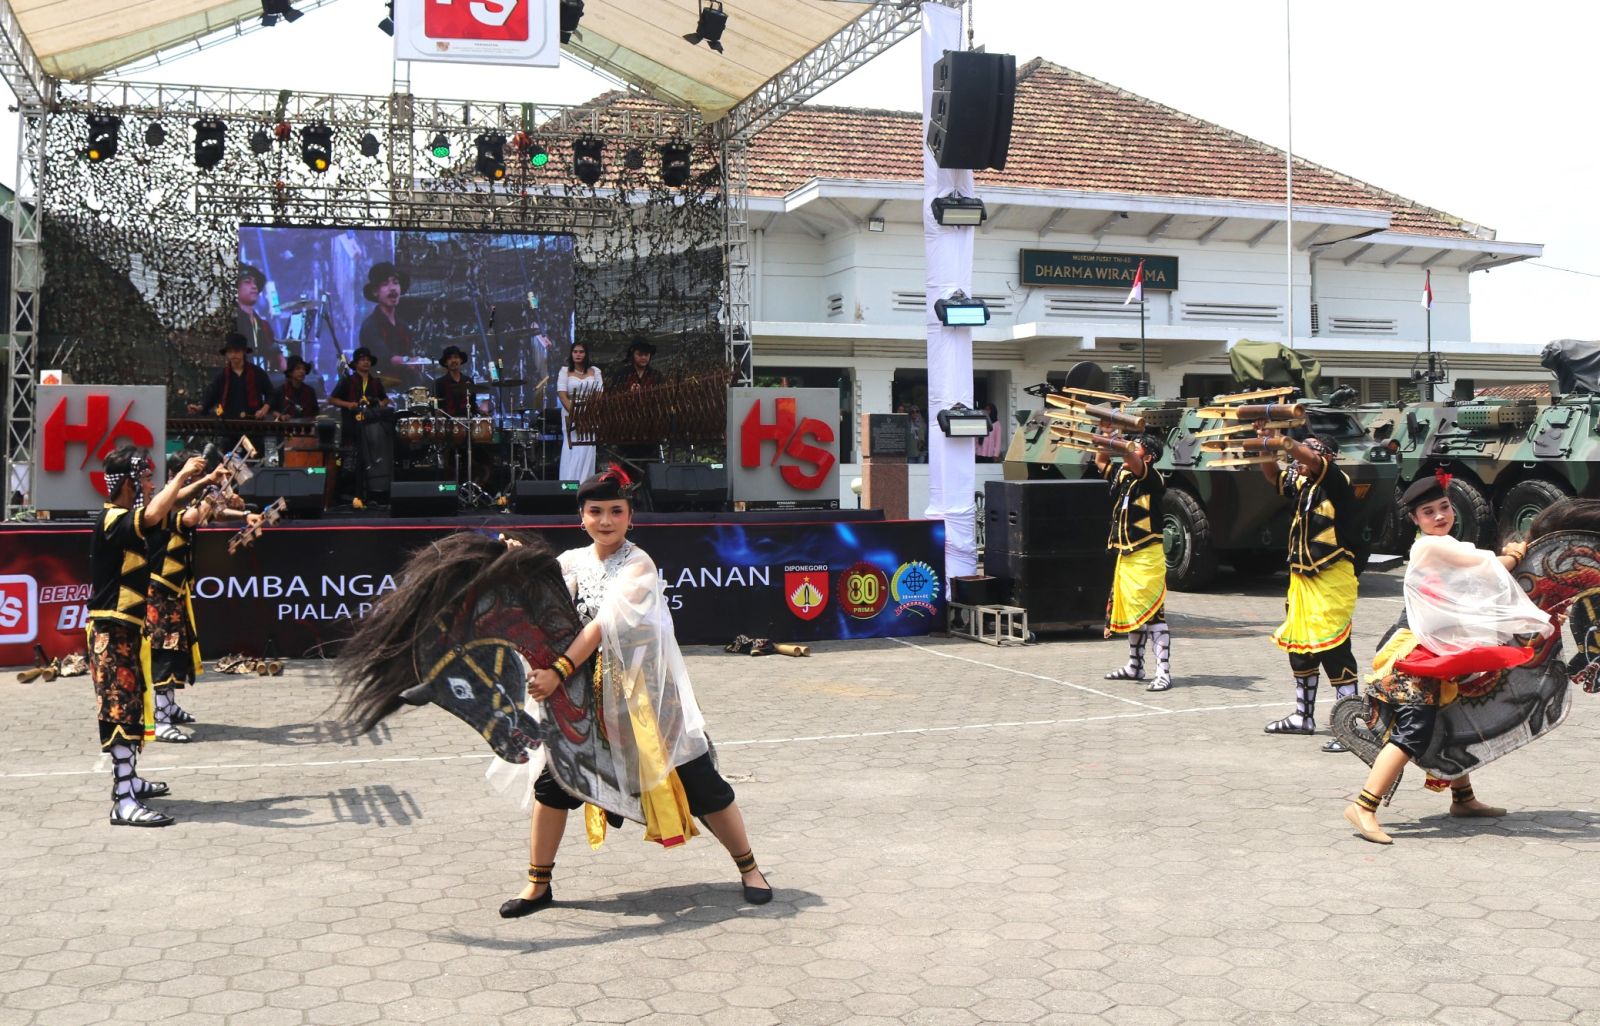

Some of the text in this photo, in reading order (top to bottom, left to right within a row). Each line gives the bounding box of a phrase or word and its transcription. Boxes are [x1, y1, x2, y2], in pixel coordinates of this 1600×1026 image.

[1035, 264, 1166, 282] DHARMA WIRATMA
[784, 564, 828, 572] DIPONEGORO
[40, 584, 93, 604] BERA
[189, 575, 310, 598] OMBA
[321, 574, 411, 597] NGA
[848, 574, 880, 605] 80
[278, 603, 351, 620] PIALA
